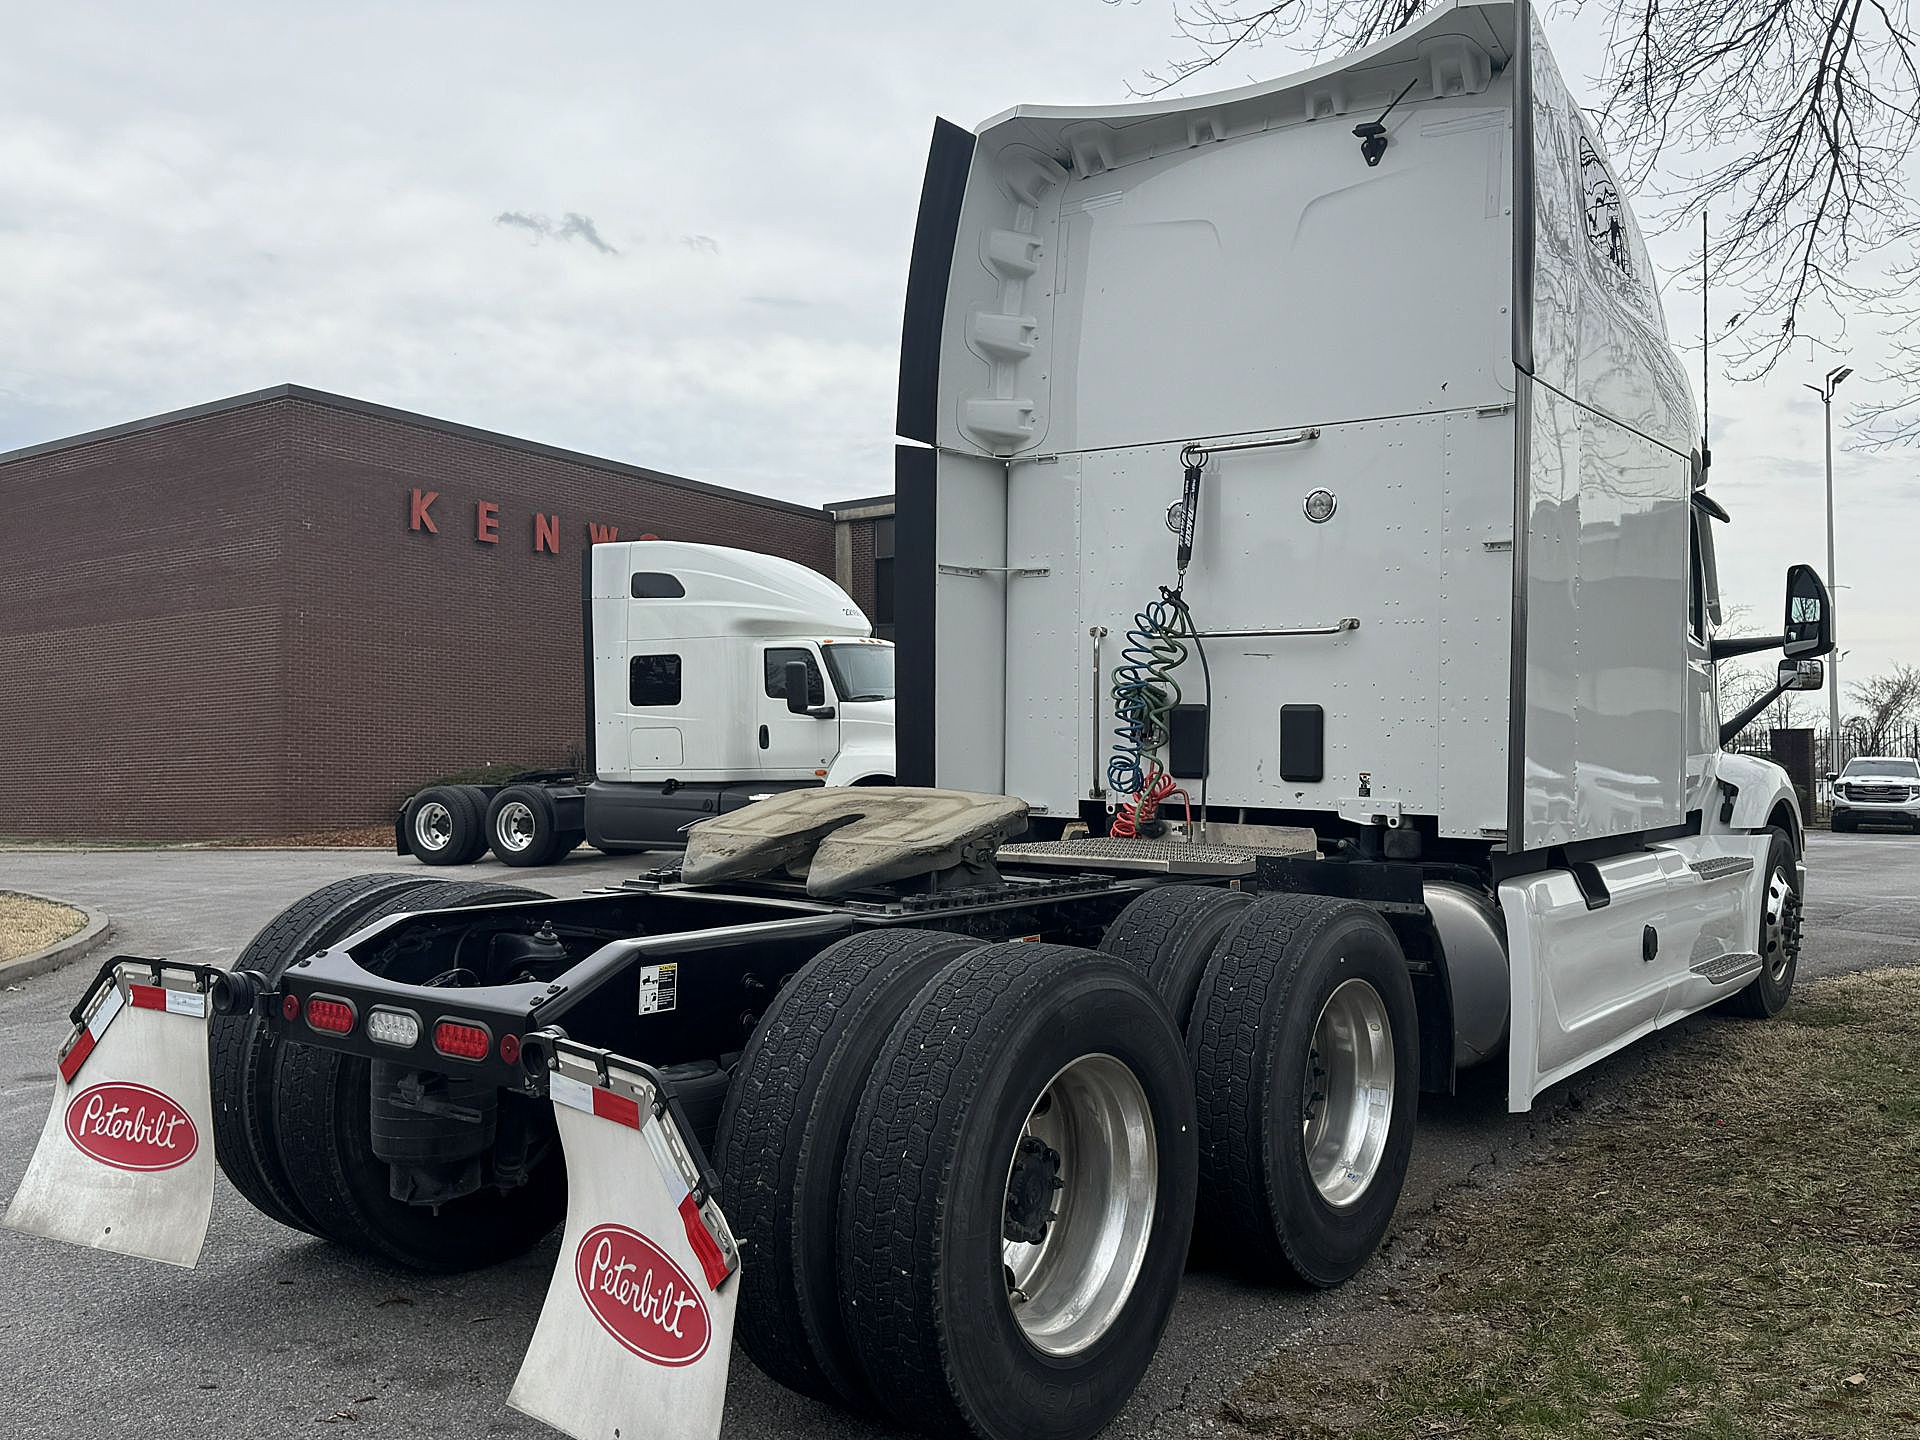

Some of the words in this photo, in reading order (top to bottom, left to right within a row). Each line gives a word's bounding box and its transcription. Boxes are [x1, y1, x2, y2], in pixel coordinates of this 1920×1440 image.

[409, 488, 660, 554] KENW
[1184, 507, 1194, 548] TRACKER
[79, 1094, 185, 1149] Peterbilt
[589, 1237, 697, 1338] Peterbilt
